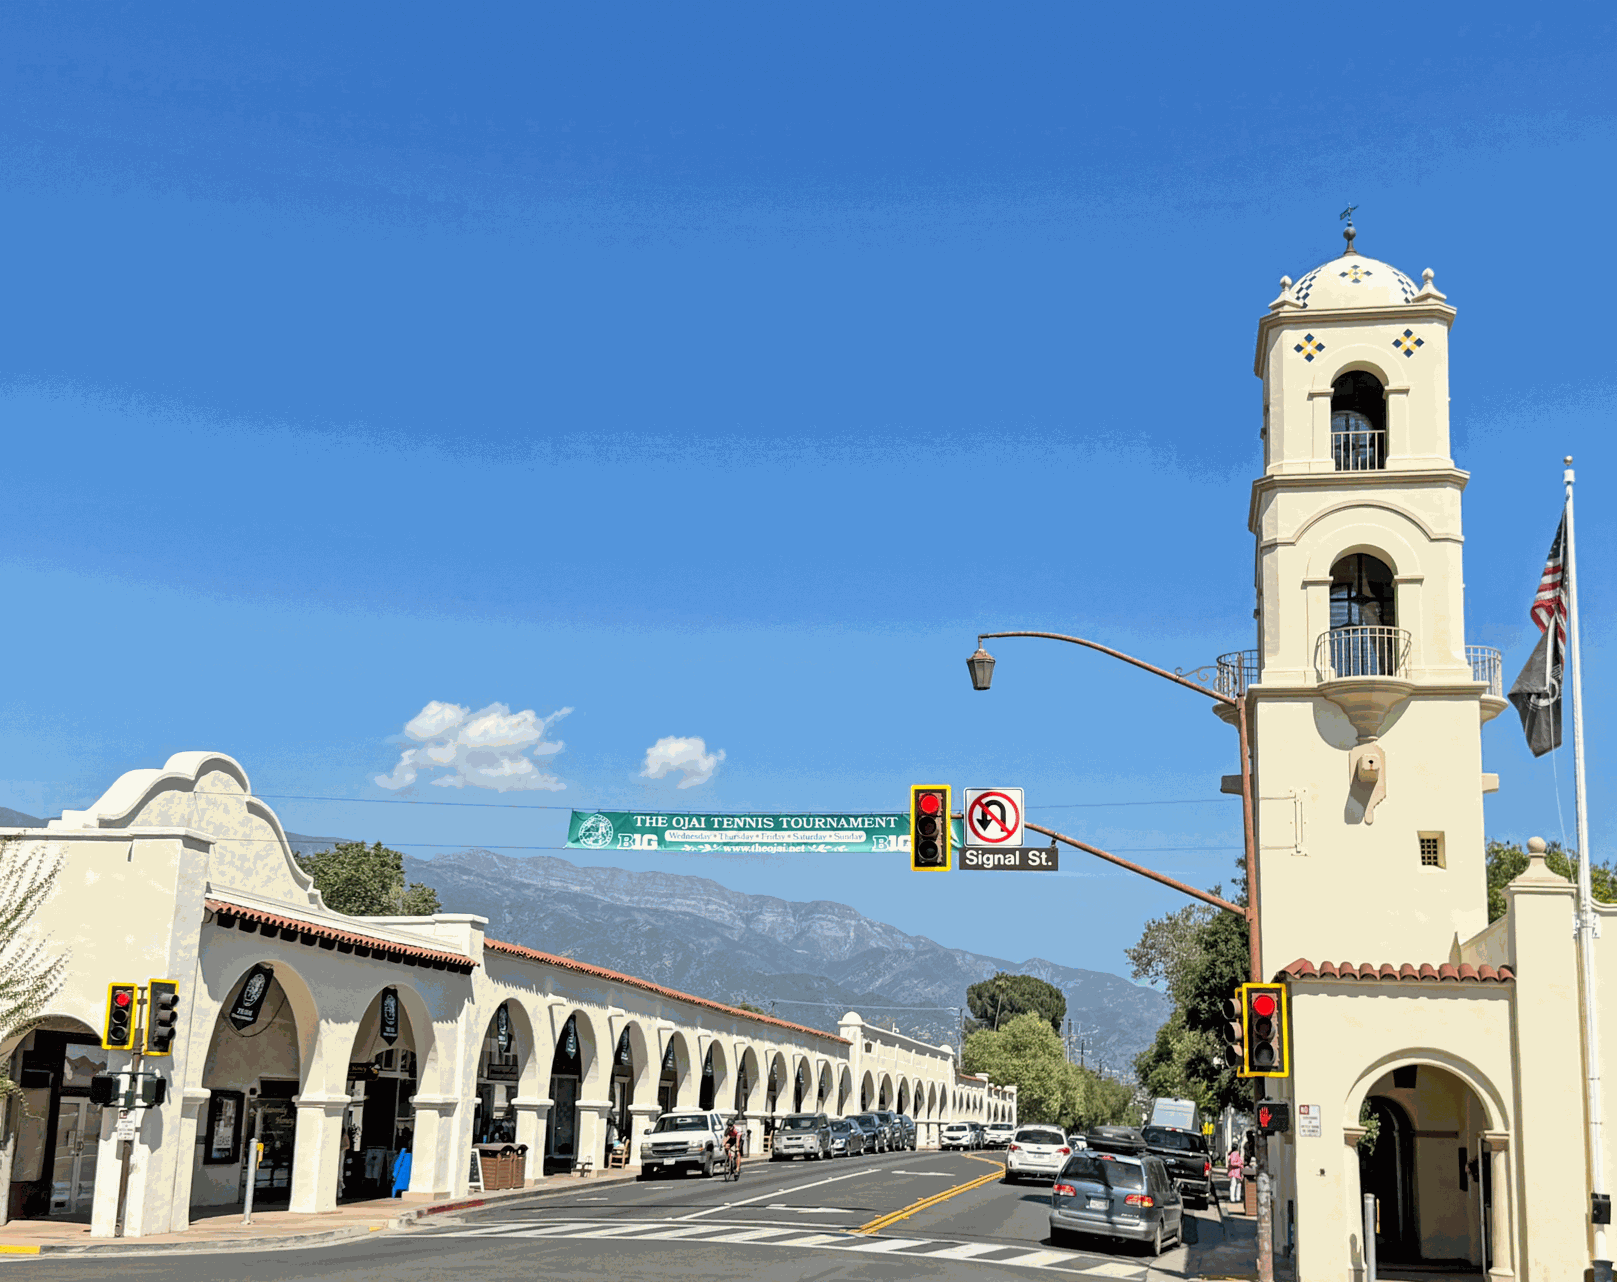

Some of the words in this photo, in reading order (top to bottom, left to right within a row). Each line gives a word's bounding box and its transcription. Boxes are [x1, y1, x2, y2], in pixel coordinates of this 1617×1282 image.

[633, 815, 668, 827] THE
[672, 816, 706, 829] OJAI
[710, 817, 774, 829] TENNIS
[779, 816, 898, 829] TOURNAMENT
[668, 831, 711, 840] Wednesday
[718, 832, 754, 841] Thursday
[761, 833, 785, 841] Friday
[793, 833, 827, 842] Saturday
[834, 833, 864, 841] Sunday
[965, 850, 1020, 868] Signal
[1028, 850, 1053, 866] St.
